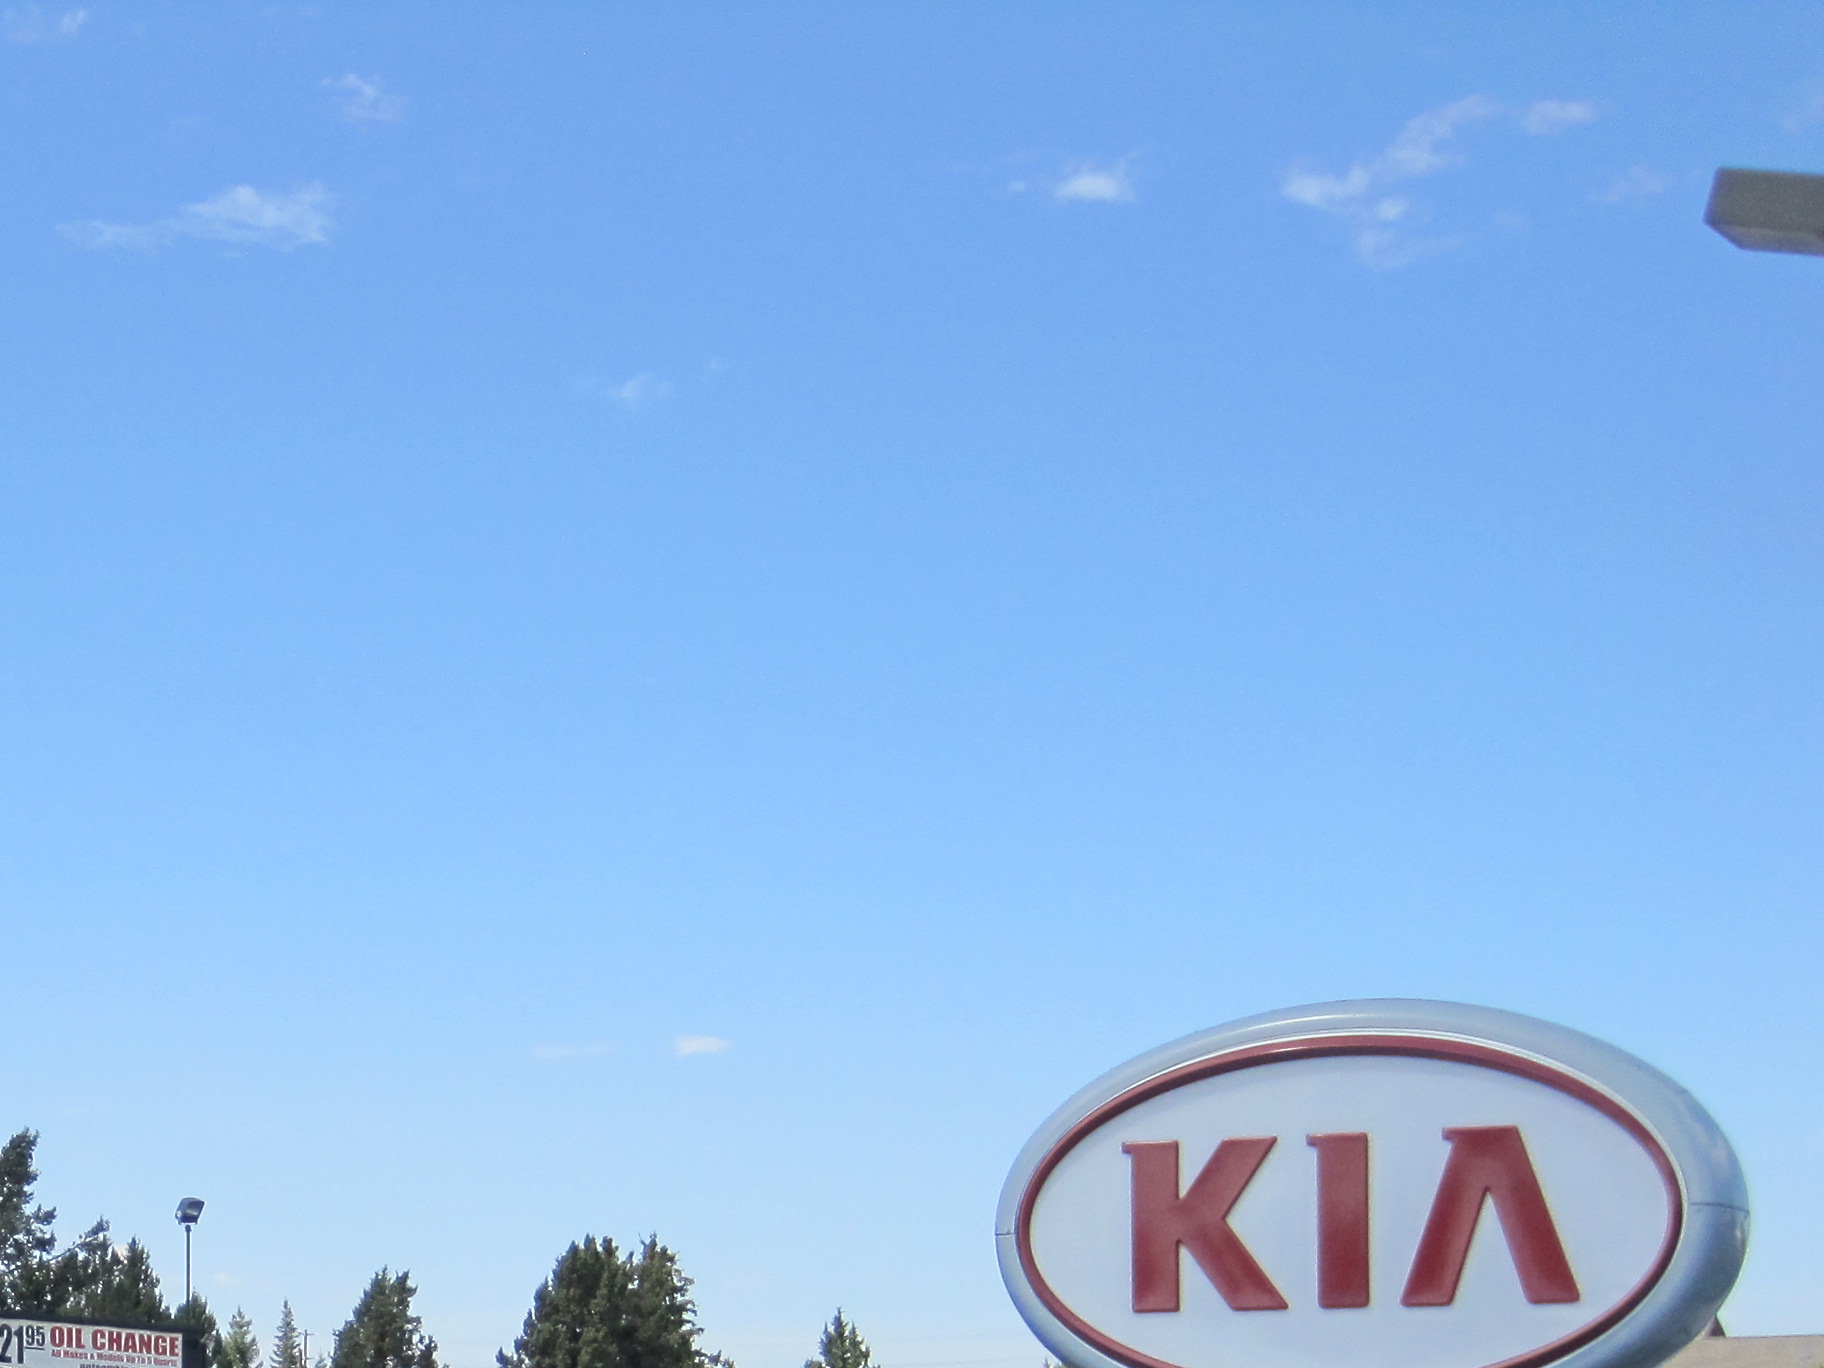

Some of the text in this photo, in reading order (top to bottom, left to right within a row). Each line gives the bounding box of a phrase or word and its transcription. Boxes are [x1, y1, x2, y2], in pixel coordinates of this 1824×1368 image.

[1119, 1124, 1582, 1314] KIA
[49, 1326, 86, 1349] OIL
[91, 1328, 180, 1357] CHANGE
